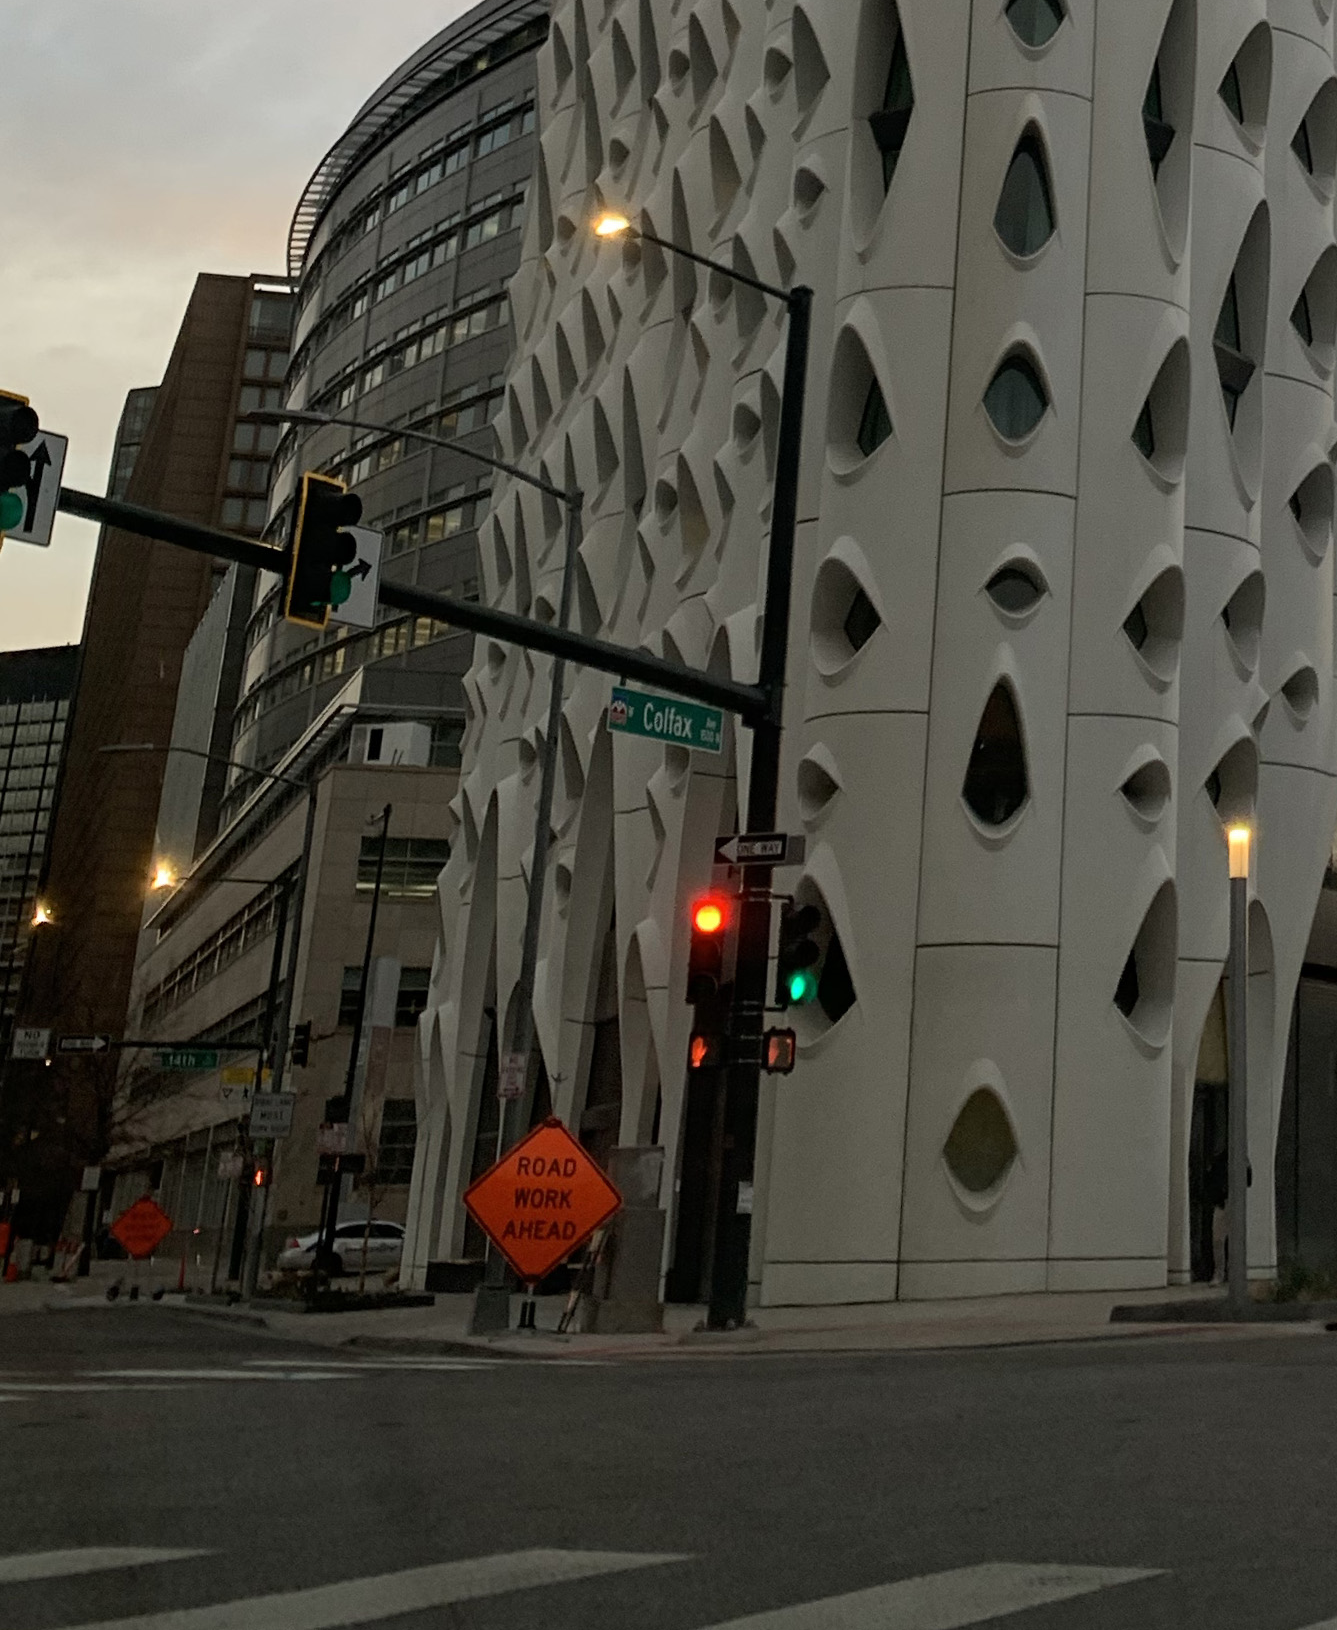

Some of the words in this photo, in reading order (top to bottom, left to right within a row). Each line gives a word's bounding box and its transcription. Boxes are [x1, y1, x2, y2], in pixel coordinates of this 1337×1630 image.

[643, 701, 693, 739] Colfax
[737, 842, 756, 857] ONE
[760, 840, 781, 855] WAY
[168, 1053, 196, 1067] 14th
[517, 1156, 577, 1178] ROAD
[514, 1187, 574, 1209] WORK
[502, 1218, 577, 1241] AHEAD
